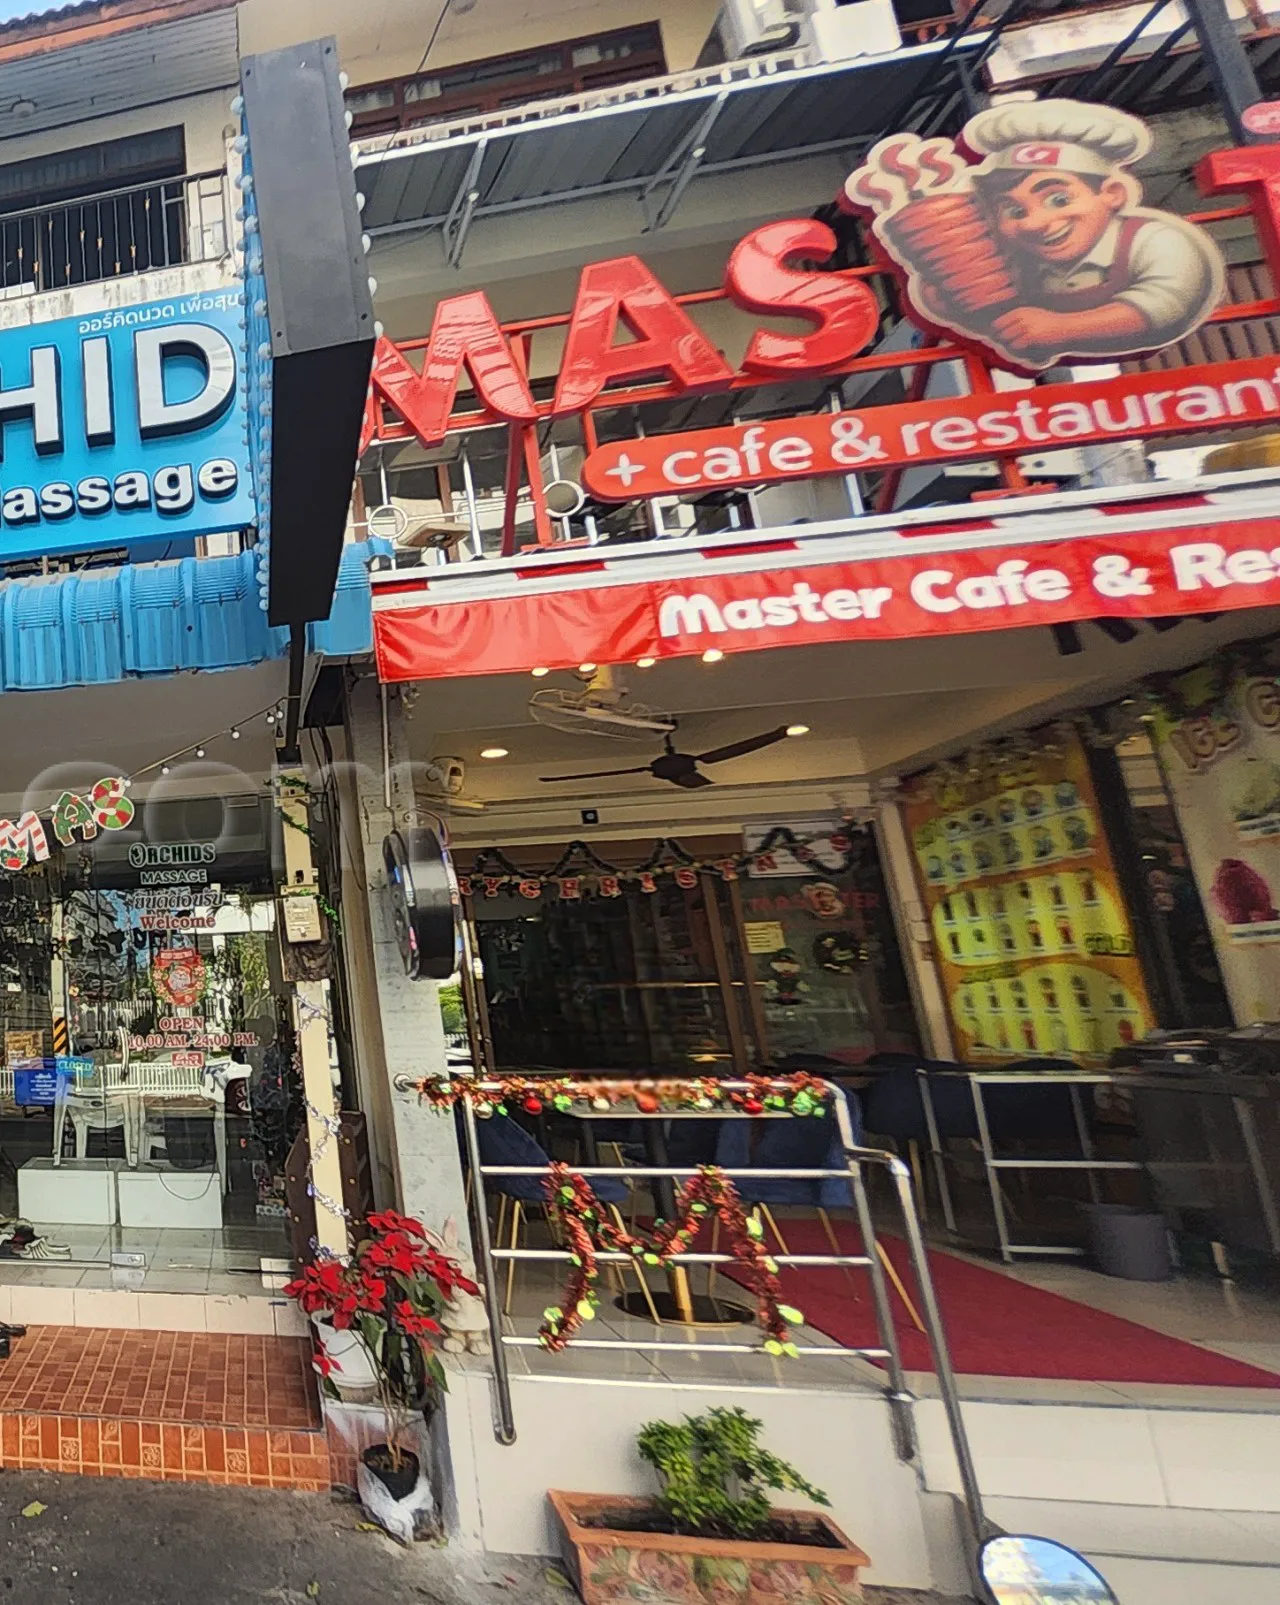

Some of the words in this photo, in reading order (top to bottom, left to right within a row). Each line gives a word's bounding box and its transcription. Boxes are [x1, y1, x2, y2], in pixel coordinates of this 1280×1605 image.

[661, 424, 812, 491] cafe
[830, 415, 893, 467] &
[658, 585, 893, 640] Master
[932, 551, 1072, 614] Cafe
[1092, 552, 1156, 598] &
[140, 869, 208, 885] MASSAGE
[140, 915, 216, 931] Welcome
[159, 1016, 205, 1031] OPEN
[57, 1060, 94, 1072] CLOSED
